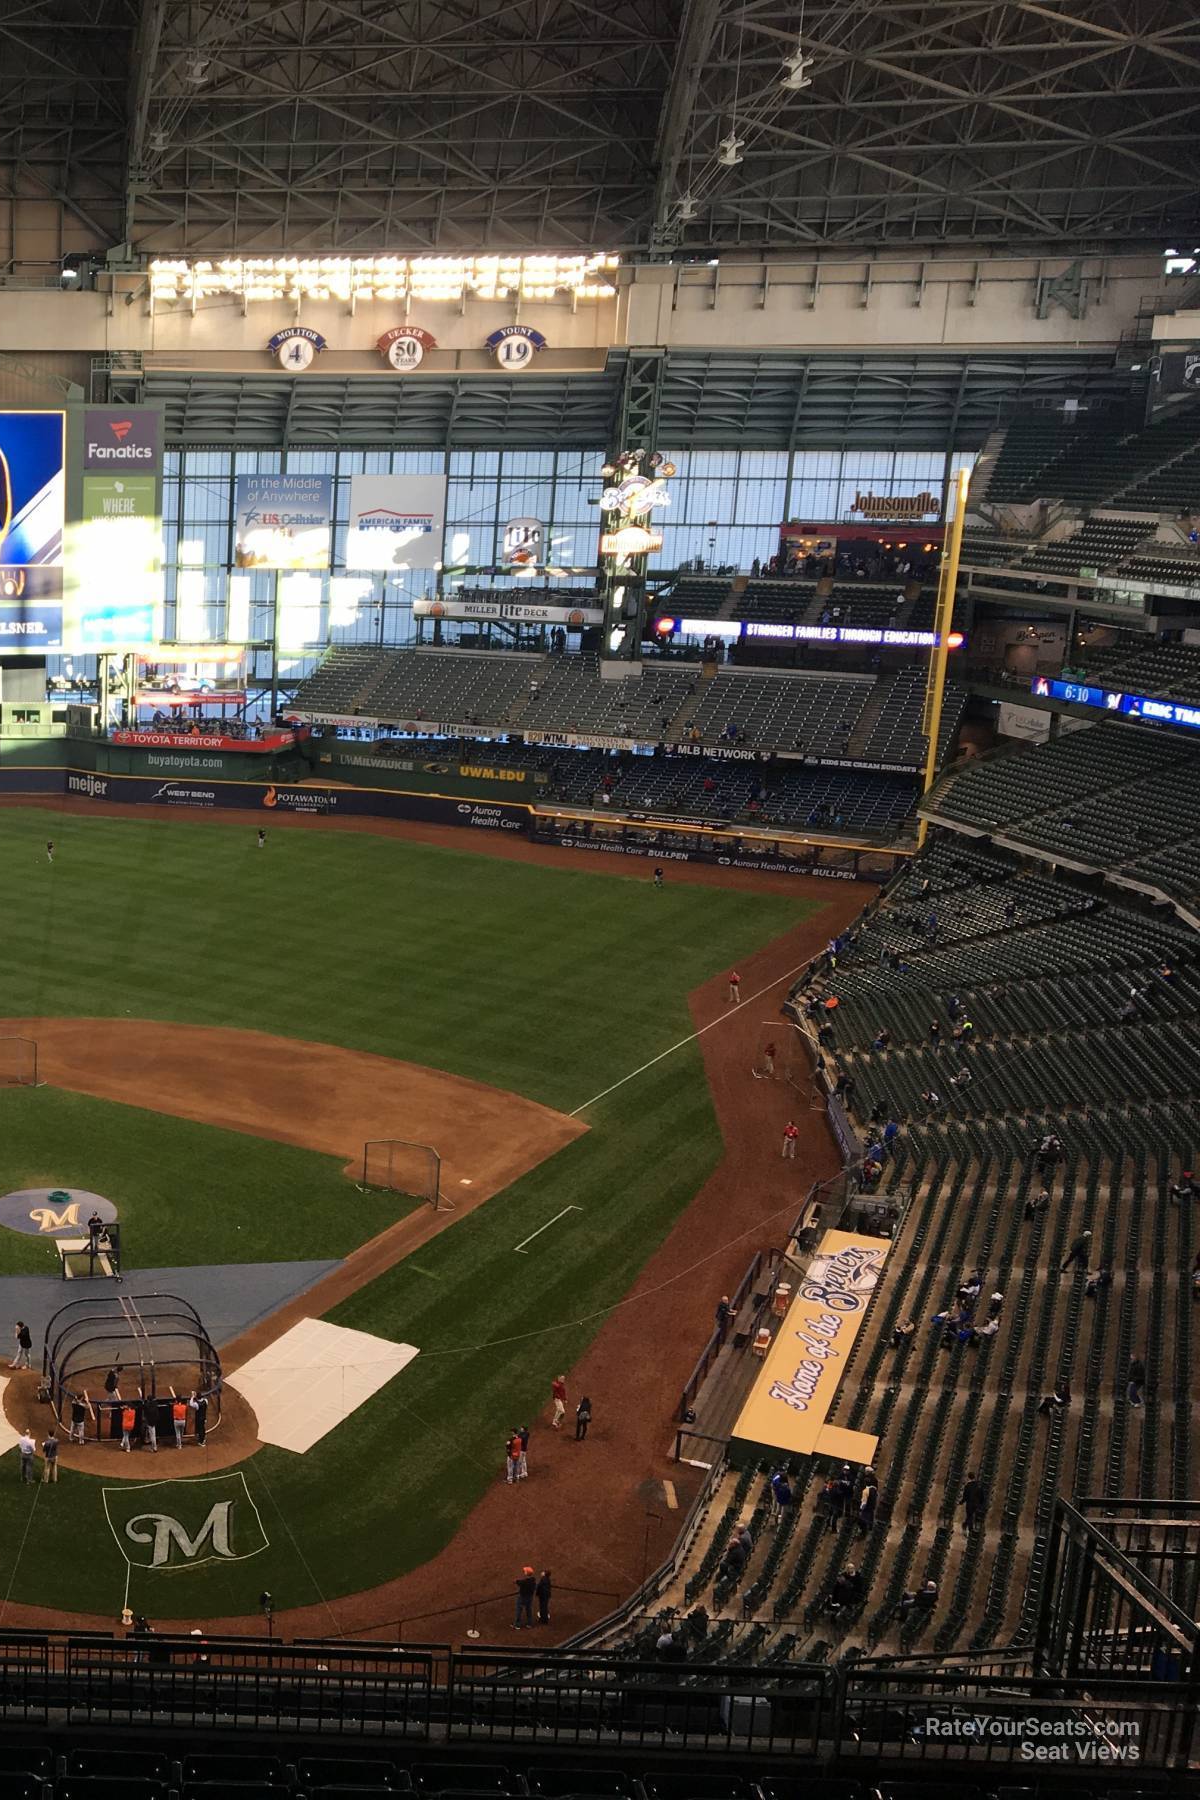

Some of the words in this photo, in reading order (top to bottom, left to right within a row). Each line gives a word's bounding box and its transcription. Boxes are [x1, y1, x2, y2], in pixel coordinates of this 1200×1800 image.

[276, 328, 318, 342] MOLITOR
[388, 327, 424, 340] UECKER
[500, 326, 534, 338] YOUNT
[289, 343, 301, 362] 4
[395, 341, 416, 358] 50
[503, 342, 529, 363] 19
[88, 443, 153, 459] Fanatics
[247, 478, 259, 489] In
[261, 478, 279, 489] the
[282, 478, 322, 489] Middle
[247, 491, 260, 501] of
[261, 491, 320, 503] Anywhere
[850, 490, 941, 513] Johnsonville
[102, 497, 136, 514] WHERE
[281, 513, 325, 526] Cellular
[863, 511, 894, 519] PARTY
[464, 604, 497, 614] MILLER
[523, 608, 549, 617] DECK
[746, 622, 794, 637] STRONGER
[795, 624, 837, 639] FAMILIES
[839, 627, 882, 642] THROUGH
[883, 630, 936, 645] EDUCATION
[1065, 685, 1089, 703] 6:10
[132, 734, 171, 745] TOYOTA
[172, 735, 223, 747] TERRITORY
[543, 733, 568, 744] WTMJ
[148, 753, 223, 768] buyatoyota.com
[677, 744, 701, 756] MLB
[703, 746, 757, 761] NETWORK
[853, 761, 881, 769] CREAM
[459, 766, 526, 781] UWM.EDU
[68, 775, 108, 796] meijer
[191, 791, 215, 799] BEND
[472, 805, 502, 817] Aurora
[470, 816, 500, 827] Health
[500, 818, 521, 830] Care
[574, 840, 599, 851] Aurora
[600, 843, 625, 853] Health
[626, 846, 642, 855] Care
[647, 849, 689, 861] BULLPEN
[732, 858, 759, 870] Aurora
[760, 861, 788, 872] Health
[788, 864, 805, 875] Care
[811, 868, 857, 880] BULLPEN
[29, 1203, 82, 1232] M
[799, 1246, 884, 1312] Brewers
[805, 1313, 842, 1339] the
[796, 1331, 840, 1359] of
[768, 1360, 824, 1411] Home
[125, 1500, 238, 1568] M
